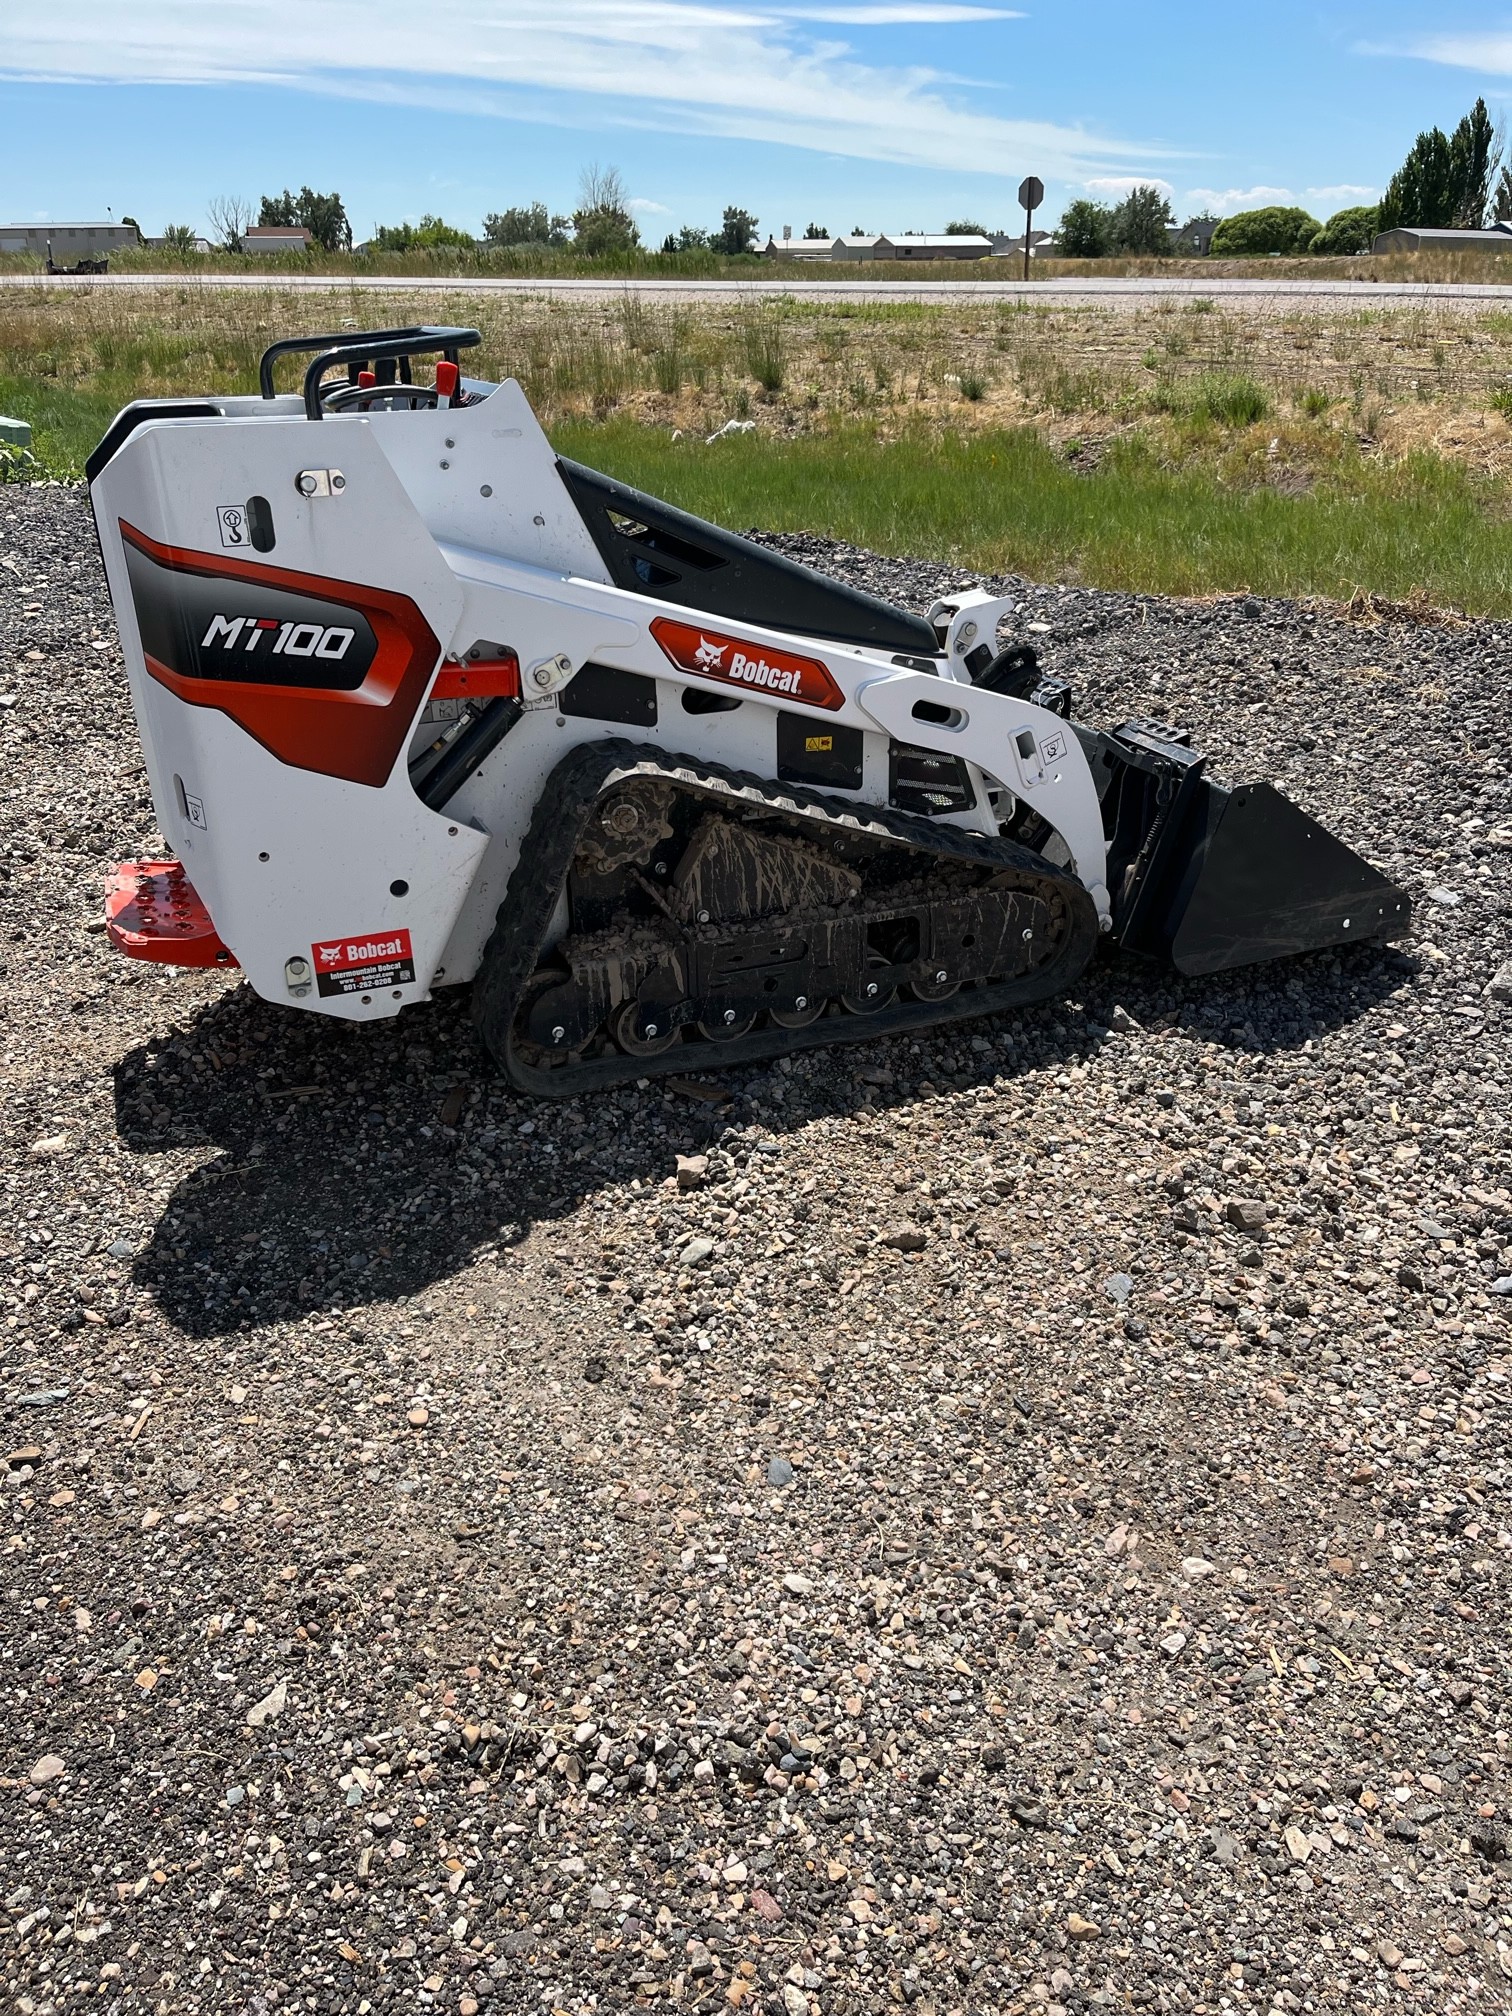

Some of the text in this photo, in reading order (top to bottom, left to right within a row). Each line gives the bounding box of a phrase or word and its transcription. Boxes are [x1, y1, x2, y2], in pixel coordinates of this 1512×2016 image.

[728, 653, 802, 694] Bobcat
[346, 938, 402, 961] Bobcat
[330, 962, 401, 980] Intermountain Bobcat
[339, 971, 394, 985] www.bobcat.com
